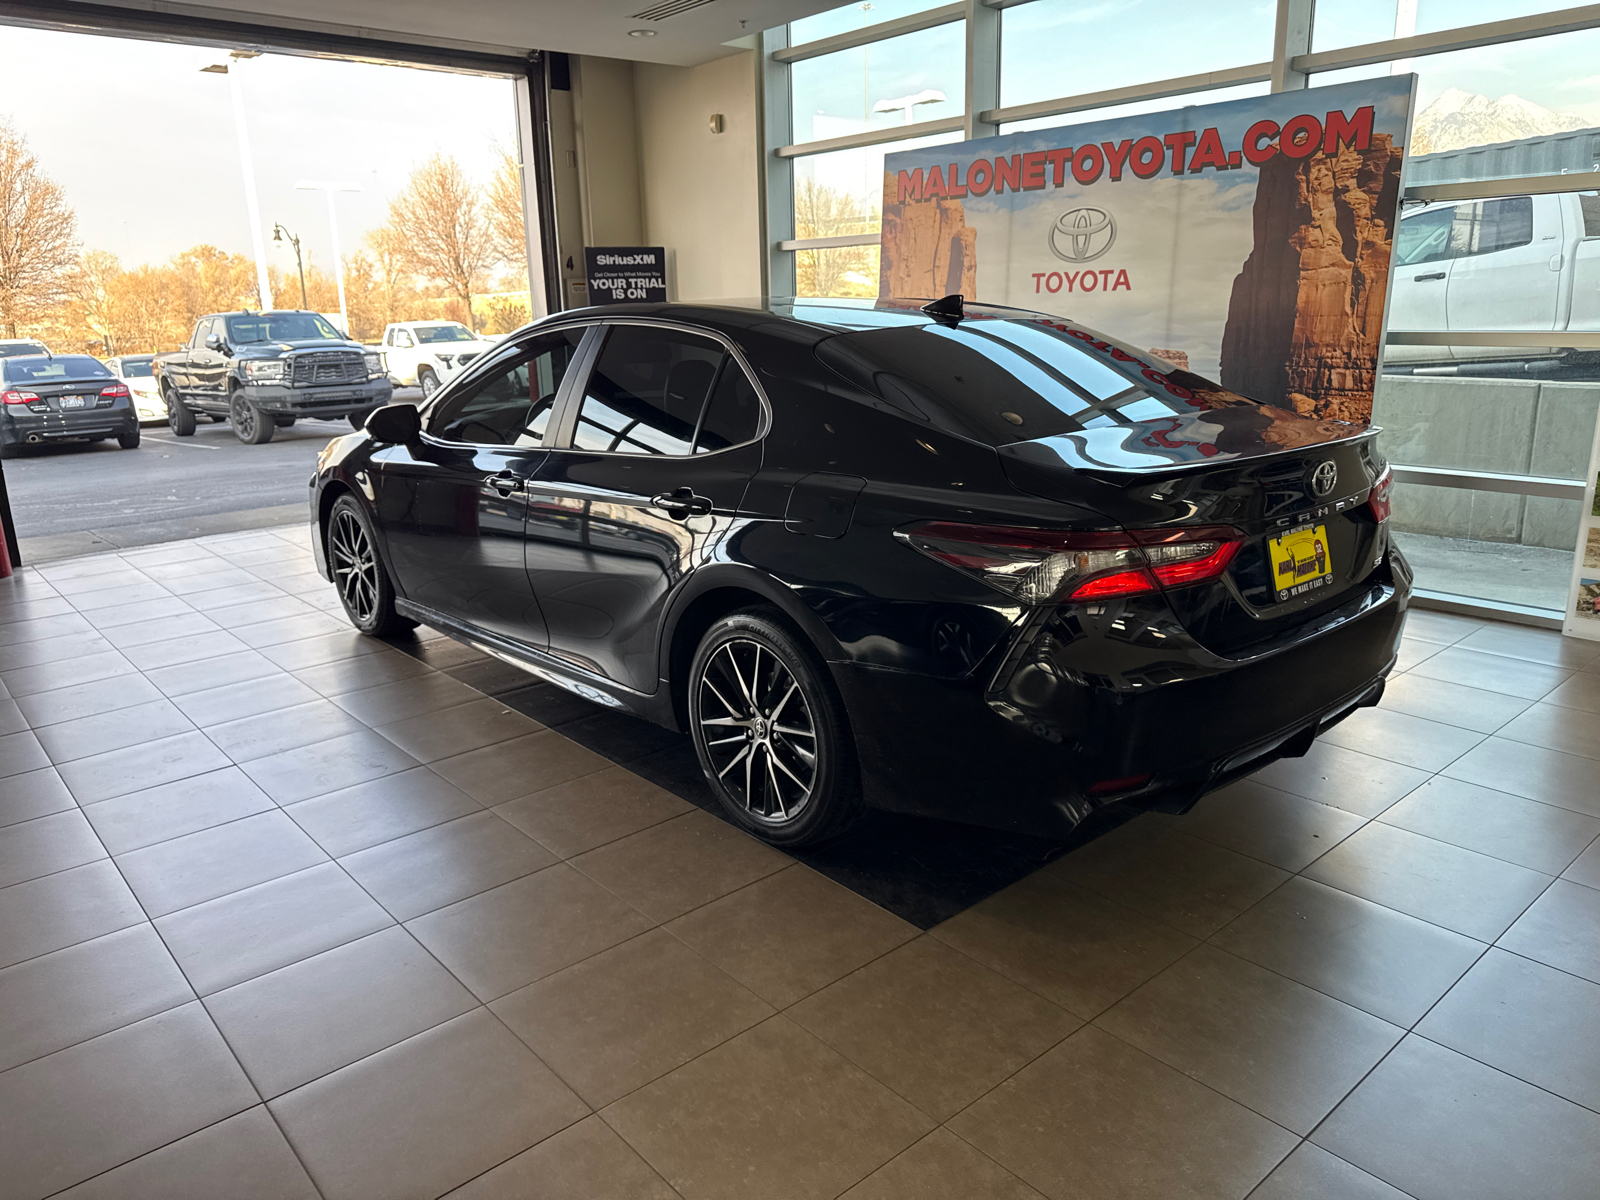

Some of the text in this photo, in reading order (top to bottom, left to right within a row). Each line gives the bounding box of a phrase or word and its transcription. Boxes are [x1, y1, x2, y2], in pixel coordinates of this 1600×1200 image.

[898, 105, 1376, 203] MALONETOYOTA.COM
[566, 255, 574, 271] 4
[596, 254, 656, 265] SiriusXM
[590, 278, 627, 290] YOUR
[628, 278, 666, 289] TRIAL
[1032, 268, 1132, 294] TOYOTA
[612, 288, 647, 299] IS ON
[1276, 495, 1359, 527] CAMRY
[1290, 577, 1324, 596] WE MAKE IT EASY
